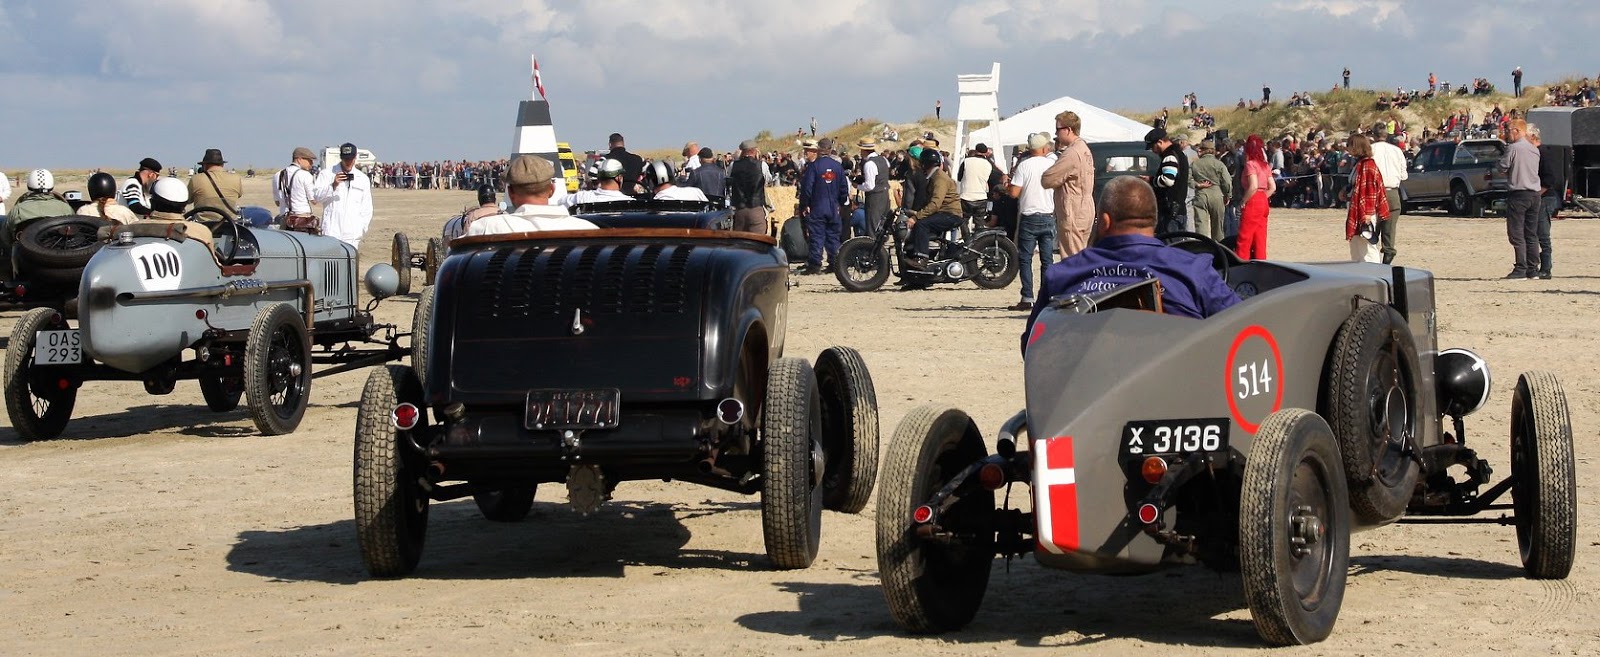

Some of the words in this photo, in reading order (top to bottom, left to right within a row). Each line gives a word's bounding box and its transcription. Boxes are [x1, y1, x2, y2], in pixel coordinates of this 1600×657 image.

[138, 250, 180, 281] 100
[48, 347, 80, 363] 293
[1238, 358, 1272, 400] 514
[1128, 427, 1144, 446] X
[1153, 424, 1221, 453] 3136
